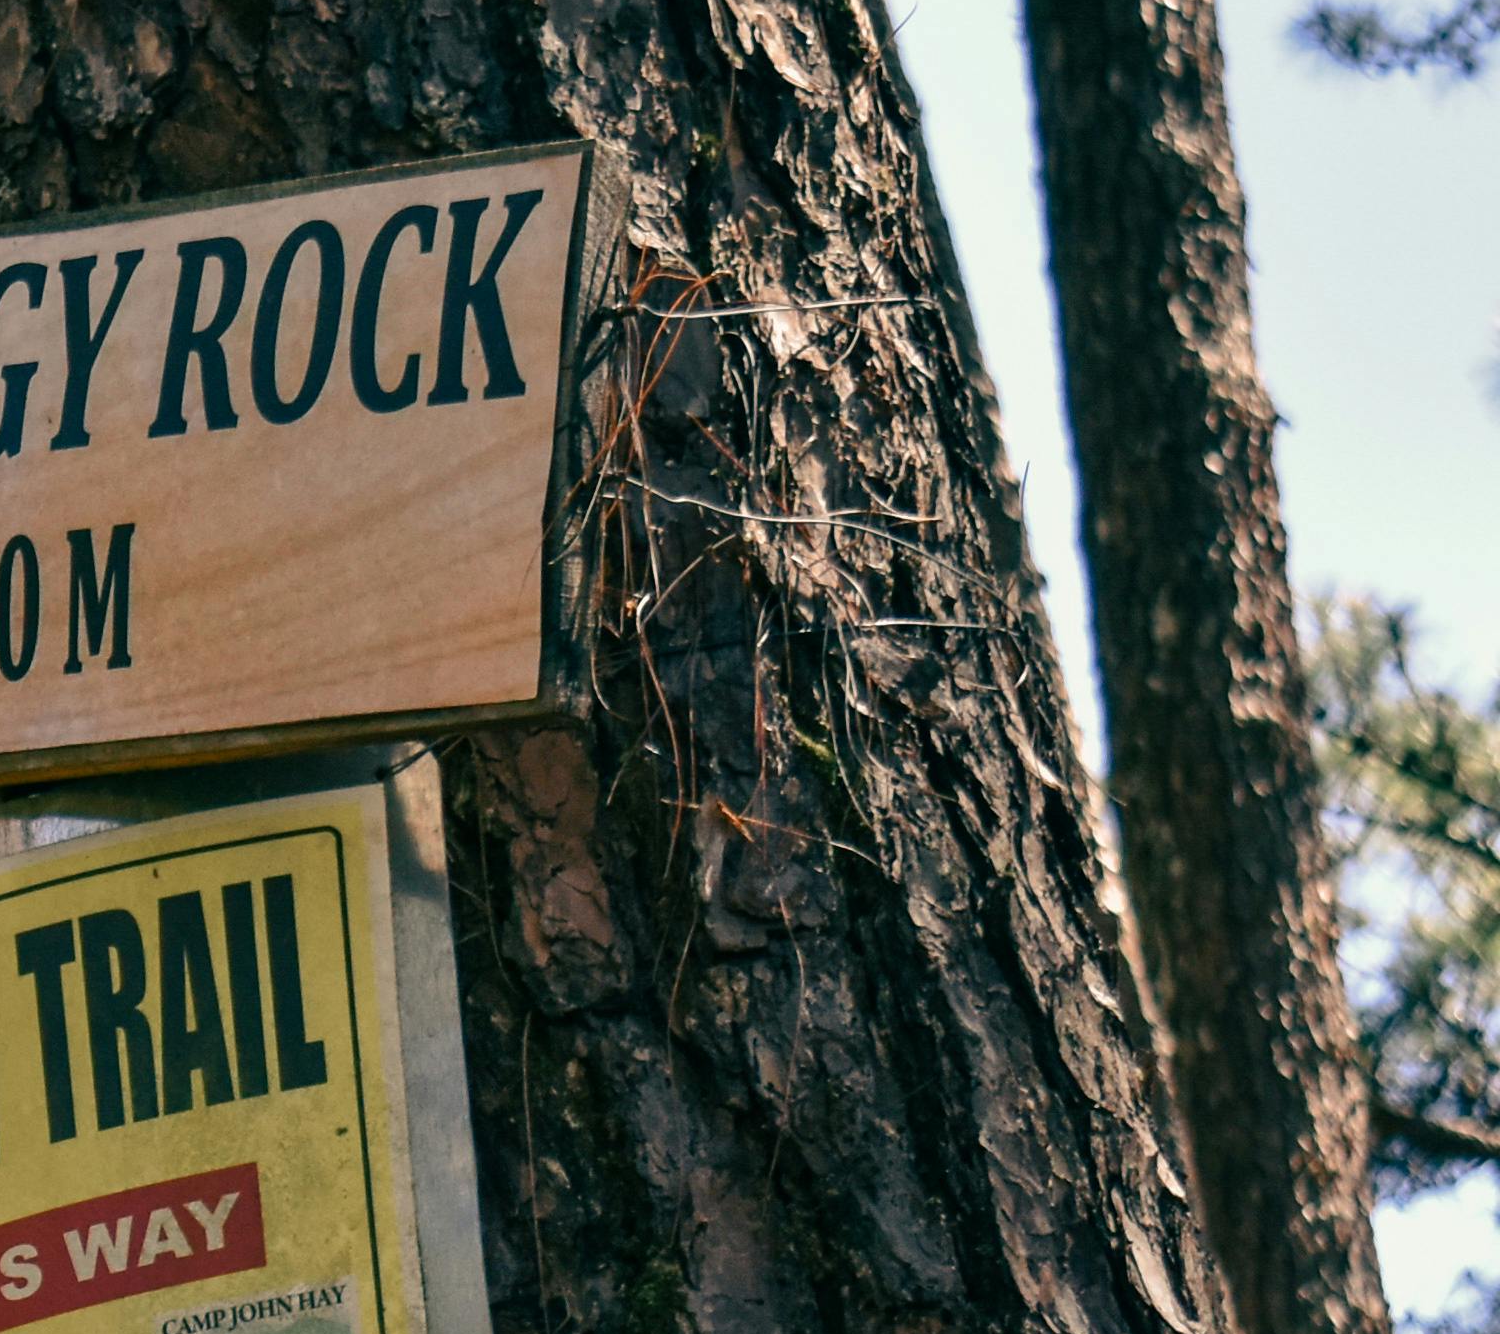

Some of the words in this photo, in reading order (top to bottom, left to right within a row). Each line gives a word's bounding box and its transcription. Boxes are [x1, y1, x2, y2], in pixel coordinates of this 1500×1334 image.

[147, 188, 544, 441] ROCK
[62, 521, 136, 675] M
[15, 873, 328, 1145] TRAIL
[62, 1190, 241, 1284] WAY
[227, 1294, 293, 1331] JOHN
[296, 1284, 347, 1309] HAY
